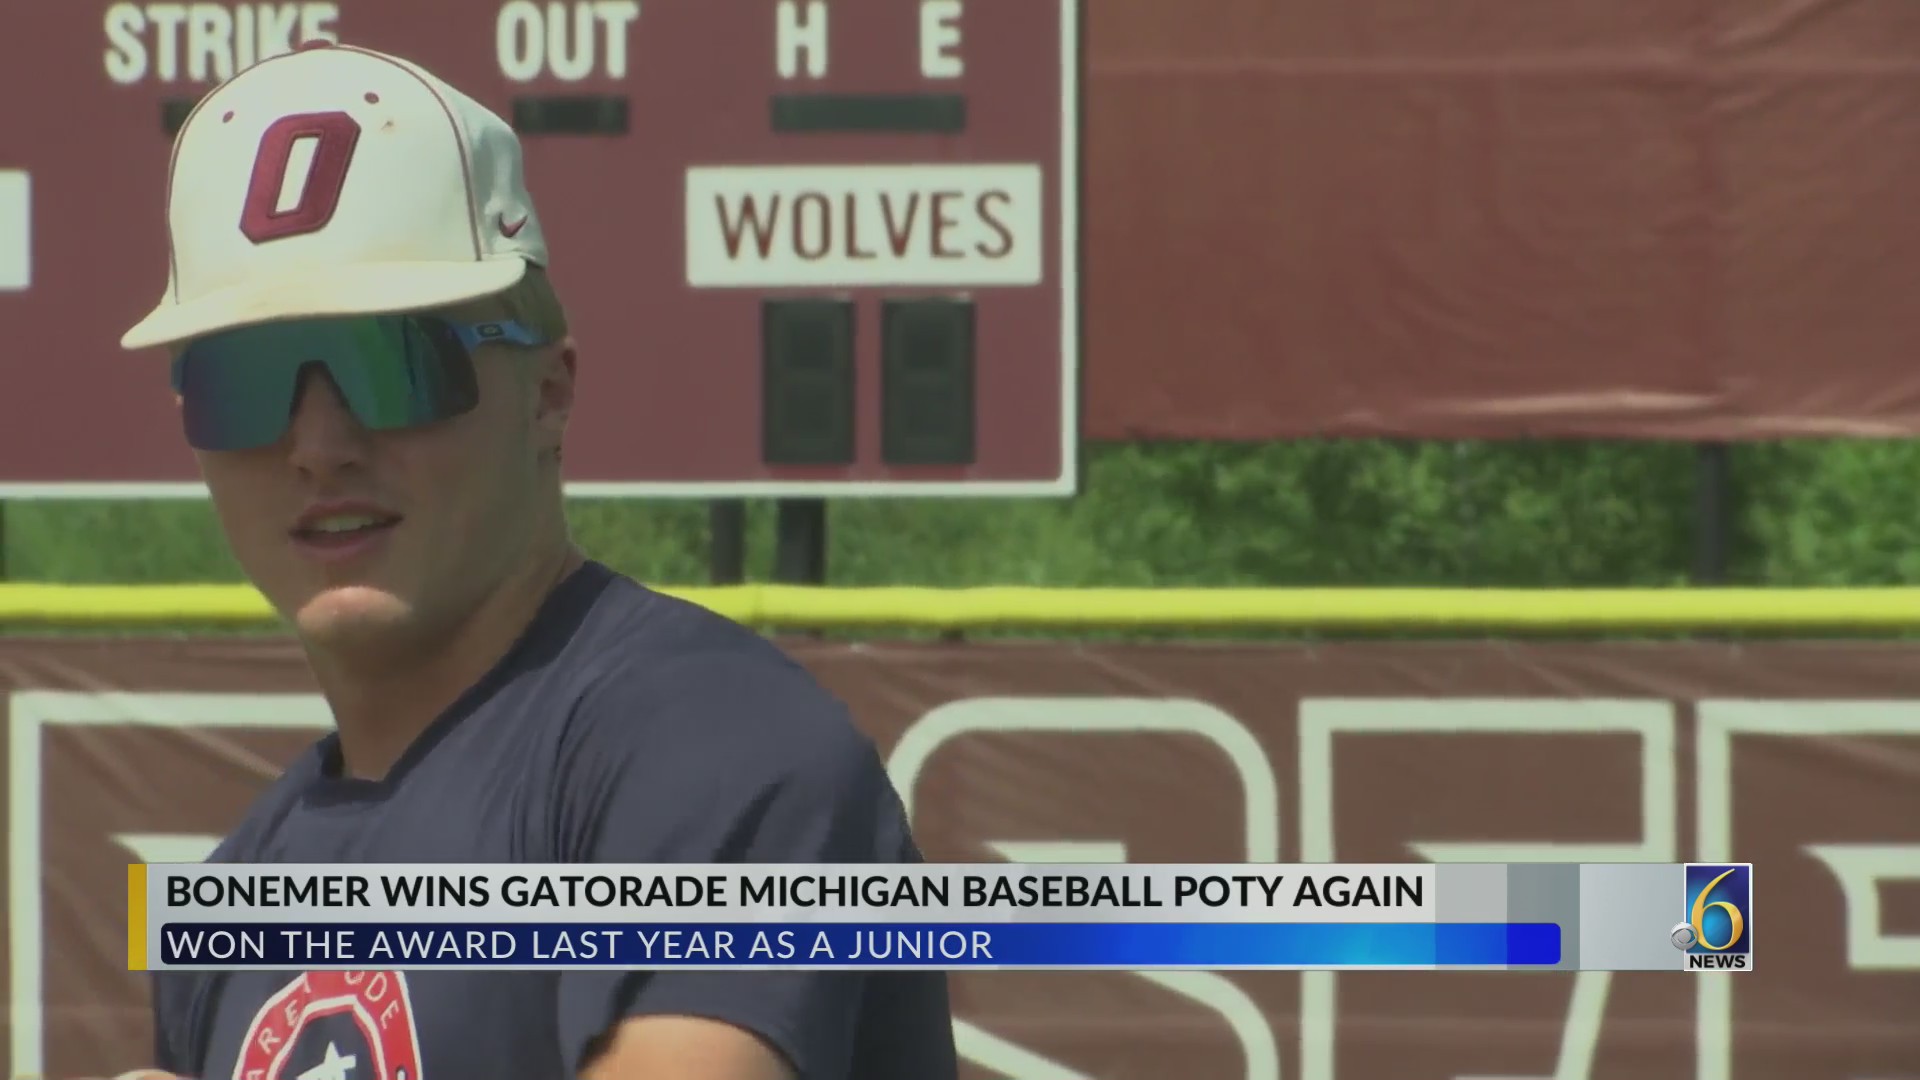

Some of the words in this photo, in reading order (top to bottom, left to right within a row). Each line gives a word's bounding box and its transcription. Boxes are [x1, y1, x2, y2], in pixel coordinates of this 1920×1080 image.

[497, 0, 639, 81] OUT
[776, 0, 828, 79] H
[920, 0, 964, 78] E
[239, 111, 361, 245] O
[715, 191, 1014, 260] WOLVES
